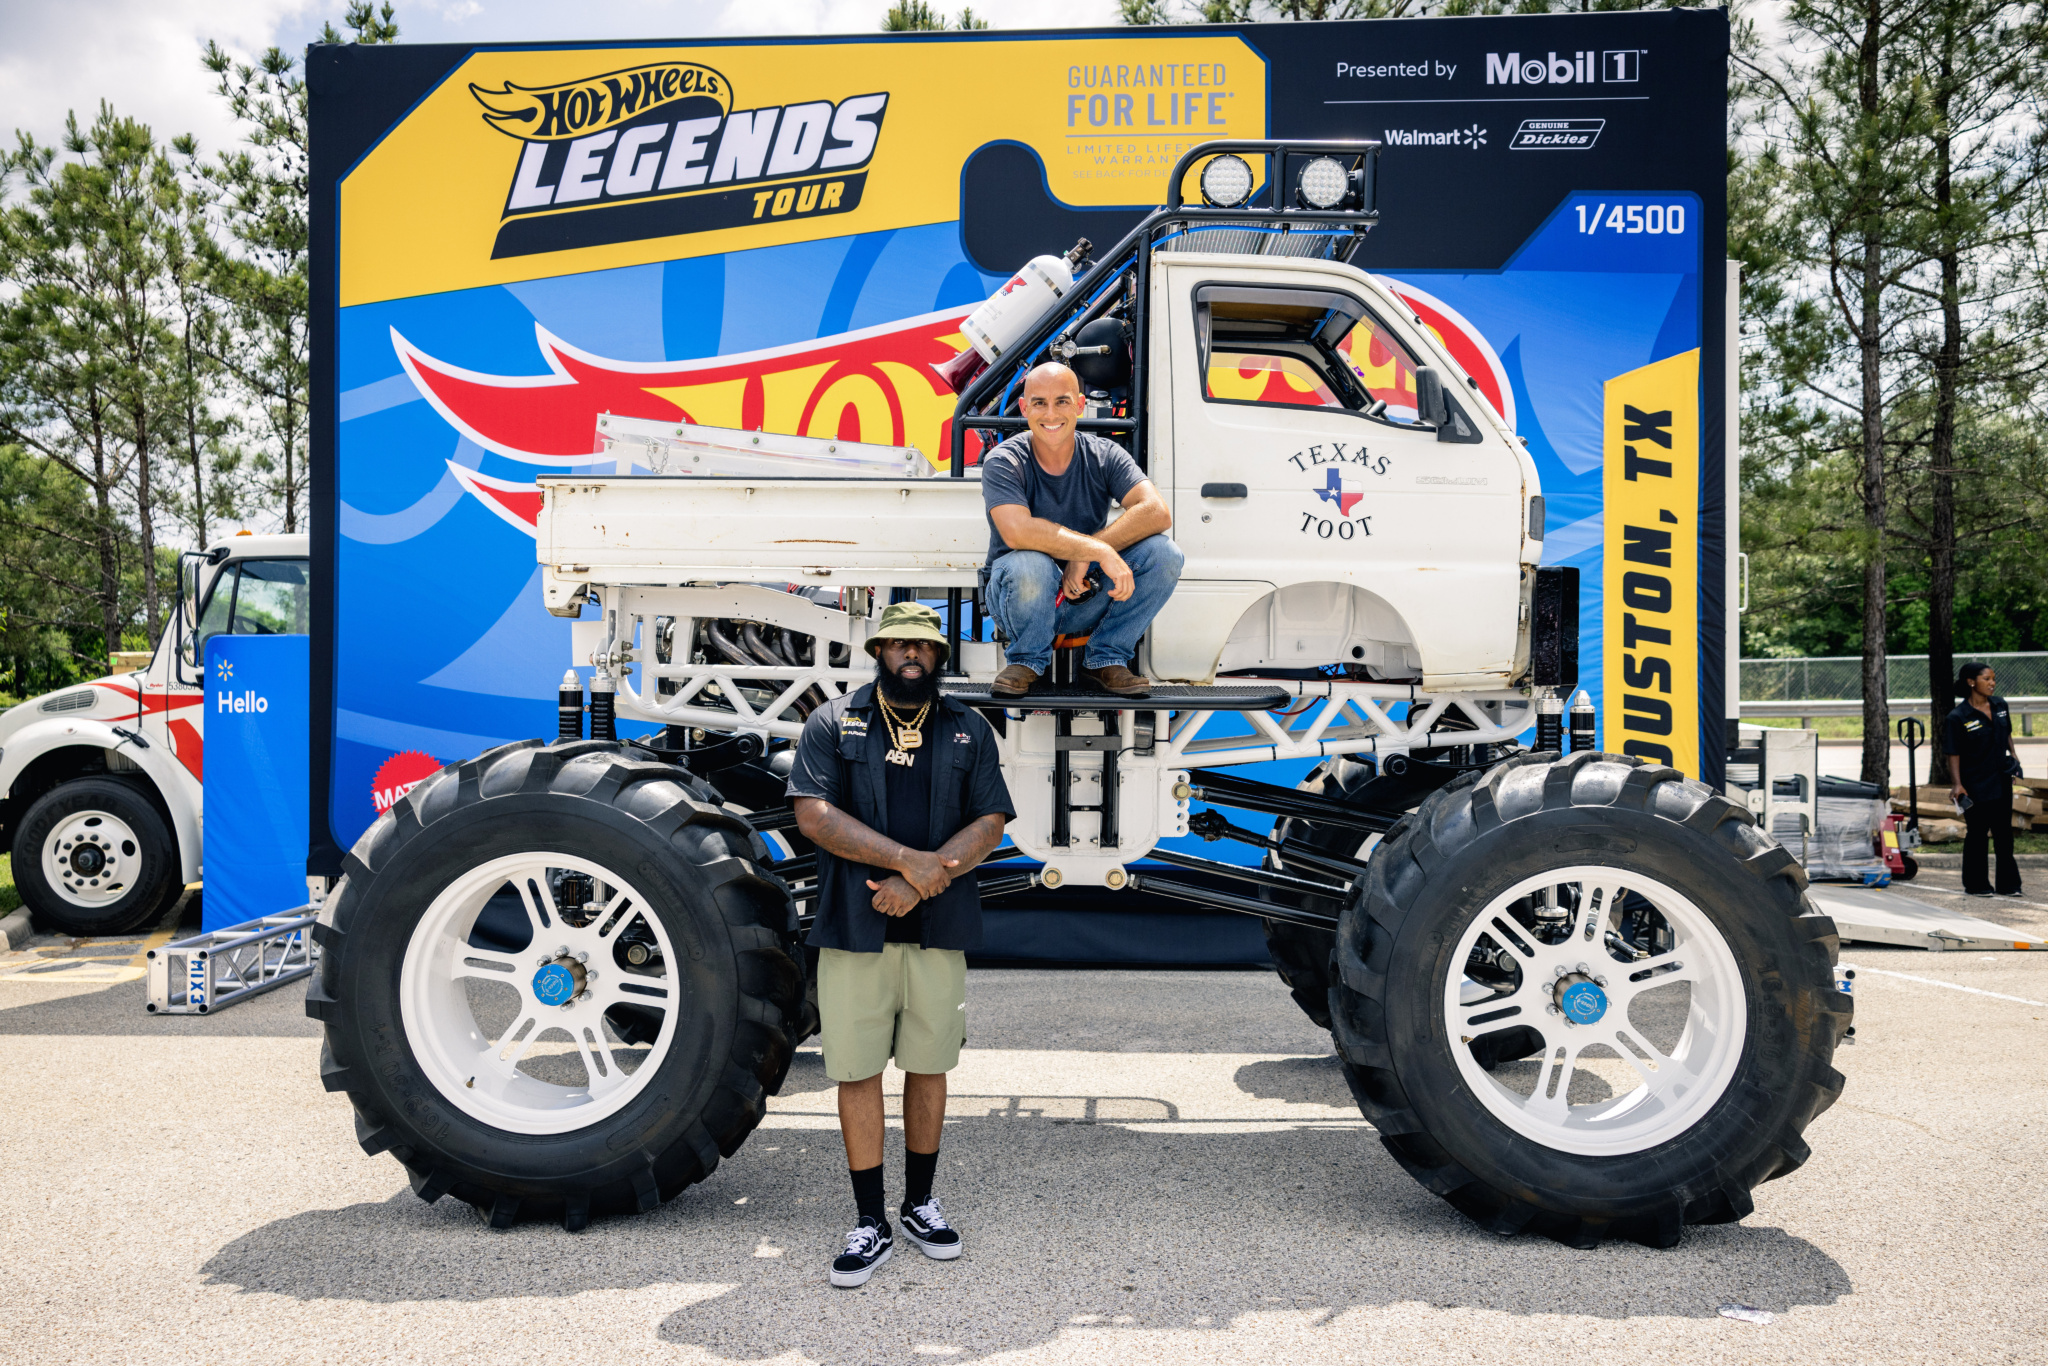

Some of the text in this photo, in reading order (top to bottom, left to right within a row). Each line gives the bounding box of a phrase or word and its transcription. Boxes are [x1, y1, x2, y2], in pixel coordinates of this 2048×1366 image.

[1068, 63, 1226, 88] GUARANTEED
[1336, 60, 1457, 80] Presented by
[1486, 51, 1595, 84] Mobil
[530, 88, 608, 136] HOT
[1067, 93, 1134, 127] FOR
[508, 94, 888, 210] LEGENDS
[1067, 143, 1197, 154] LIMITED LIFET
[1385, 129, 1460, 146] Walmart
[1519, 133, 1589, 144] Dickies
[1073, 170, 1093, 179] SEE
[1095, 170, 1126, 178] BACK
[1128, 170, 1151, 178] FOR
[1093, 155, 1180, 165] WARRANT
[752, 182, 845, 219] TOUR
[1575, 204, 1685, 235] 1/4500
[1623, 403, 1673, 482] TX
[1288, 442, 1391, 476] TEXAS
[1300, 511, 1373, 540] TOOT
[218, 690, 268, 714] Hello
[885, 749, 915, 767] ABN
[374, 779, 424, 810] MAT
